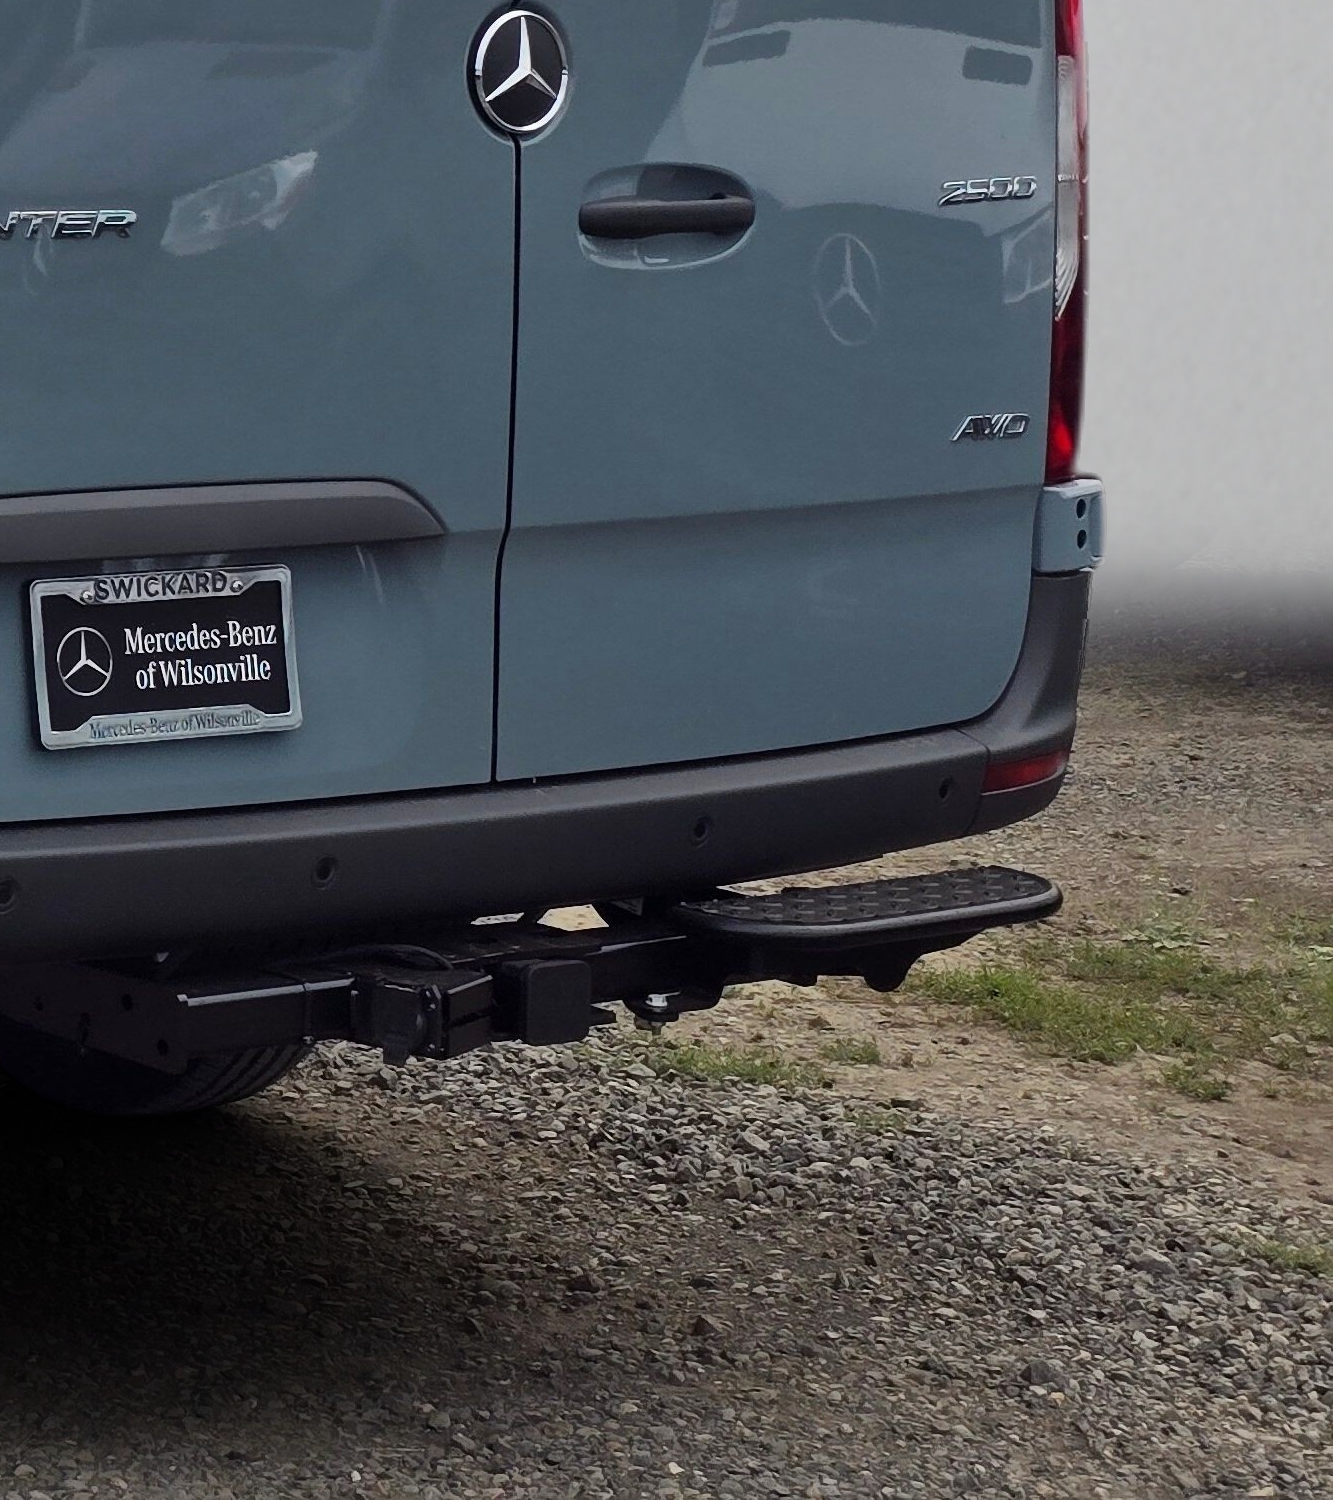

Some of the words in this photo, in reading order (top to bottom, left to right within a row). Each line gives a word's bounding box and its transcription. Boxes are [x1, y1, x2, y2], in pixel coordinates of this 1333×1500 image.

[938, 175, 1037, 207] 2500
[950, 412, 1031, 442] AWD
[93, 571, 228, 599] SWICKARD
[123, 620, 278, 655] Mercedes-Benz
[135, 661, 159, 690] of
[159, 654, 272, 688] Wilsonville
[88, 717, 178, 740] Mercedes-Benz
[181, 714, 193, 731] of
[192, 709, 261, 730] Wilsonville
